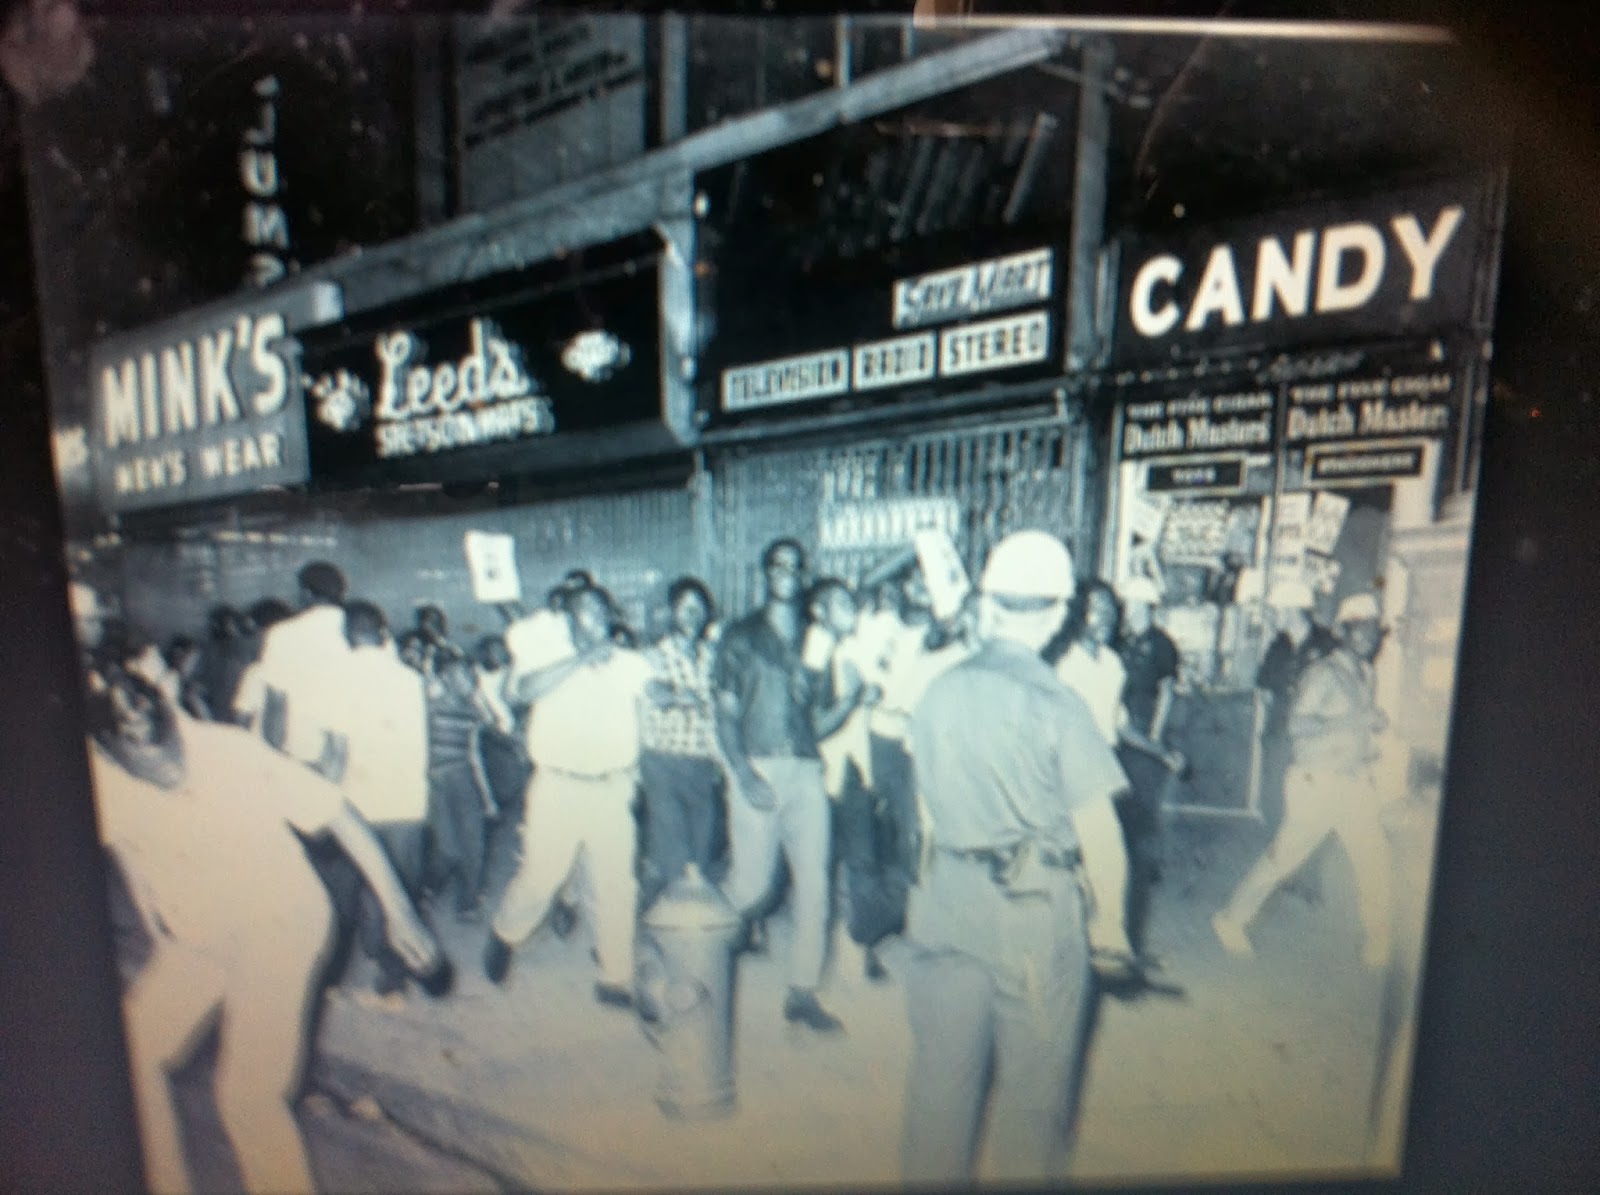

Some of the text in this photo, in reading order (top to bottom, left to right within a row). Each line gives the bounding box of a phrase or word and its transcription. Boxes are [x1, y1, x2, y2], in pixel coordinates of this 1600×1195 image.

[1129, 205, 1463, 337] CANDY
[102, 312, 287, 449] MINK'S
[950, 318, 1044, 368] STEREO
[201, 432, 280, 479] WEAR
